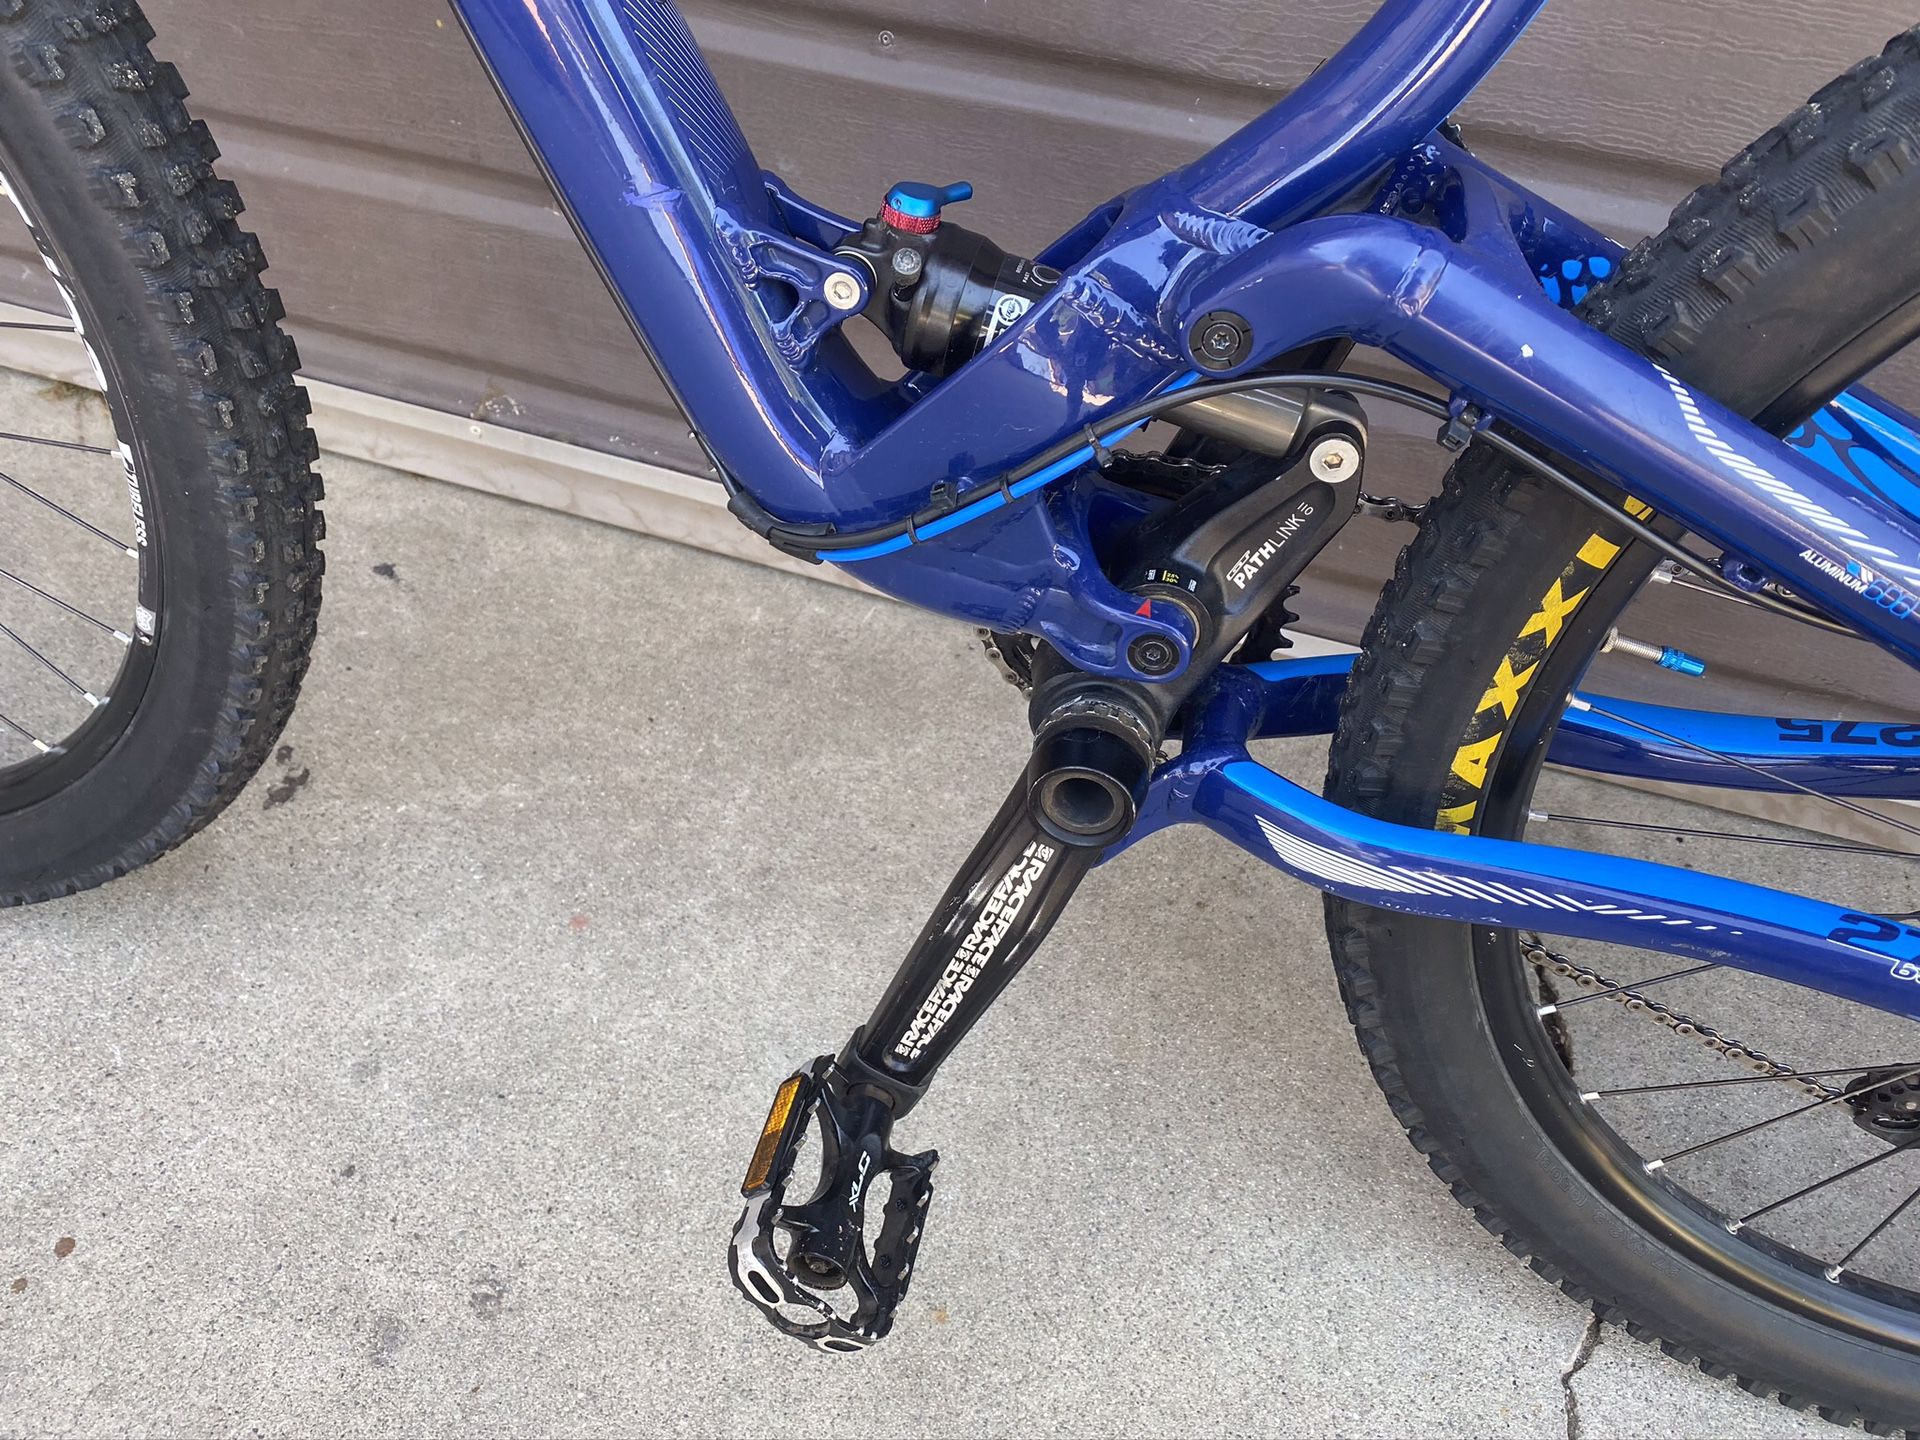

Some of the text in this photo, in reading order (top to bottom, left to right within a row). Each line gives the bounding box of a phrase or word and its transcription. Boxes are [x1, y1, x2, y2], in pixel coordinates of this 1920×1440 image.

[1233, 513, 1306, 590] PATHLINK
[1799, 549, 1868, 594] ALUMINUM
[969, 857, 1047, 970] RACEFACE
[900, 959, 964, 1047] RACEFACE
[848, 1150, 871, 1213] XLC
